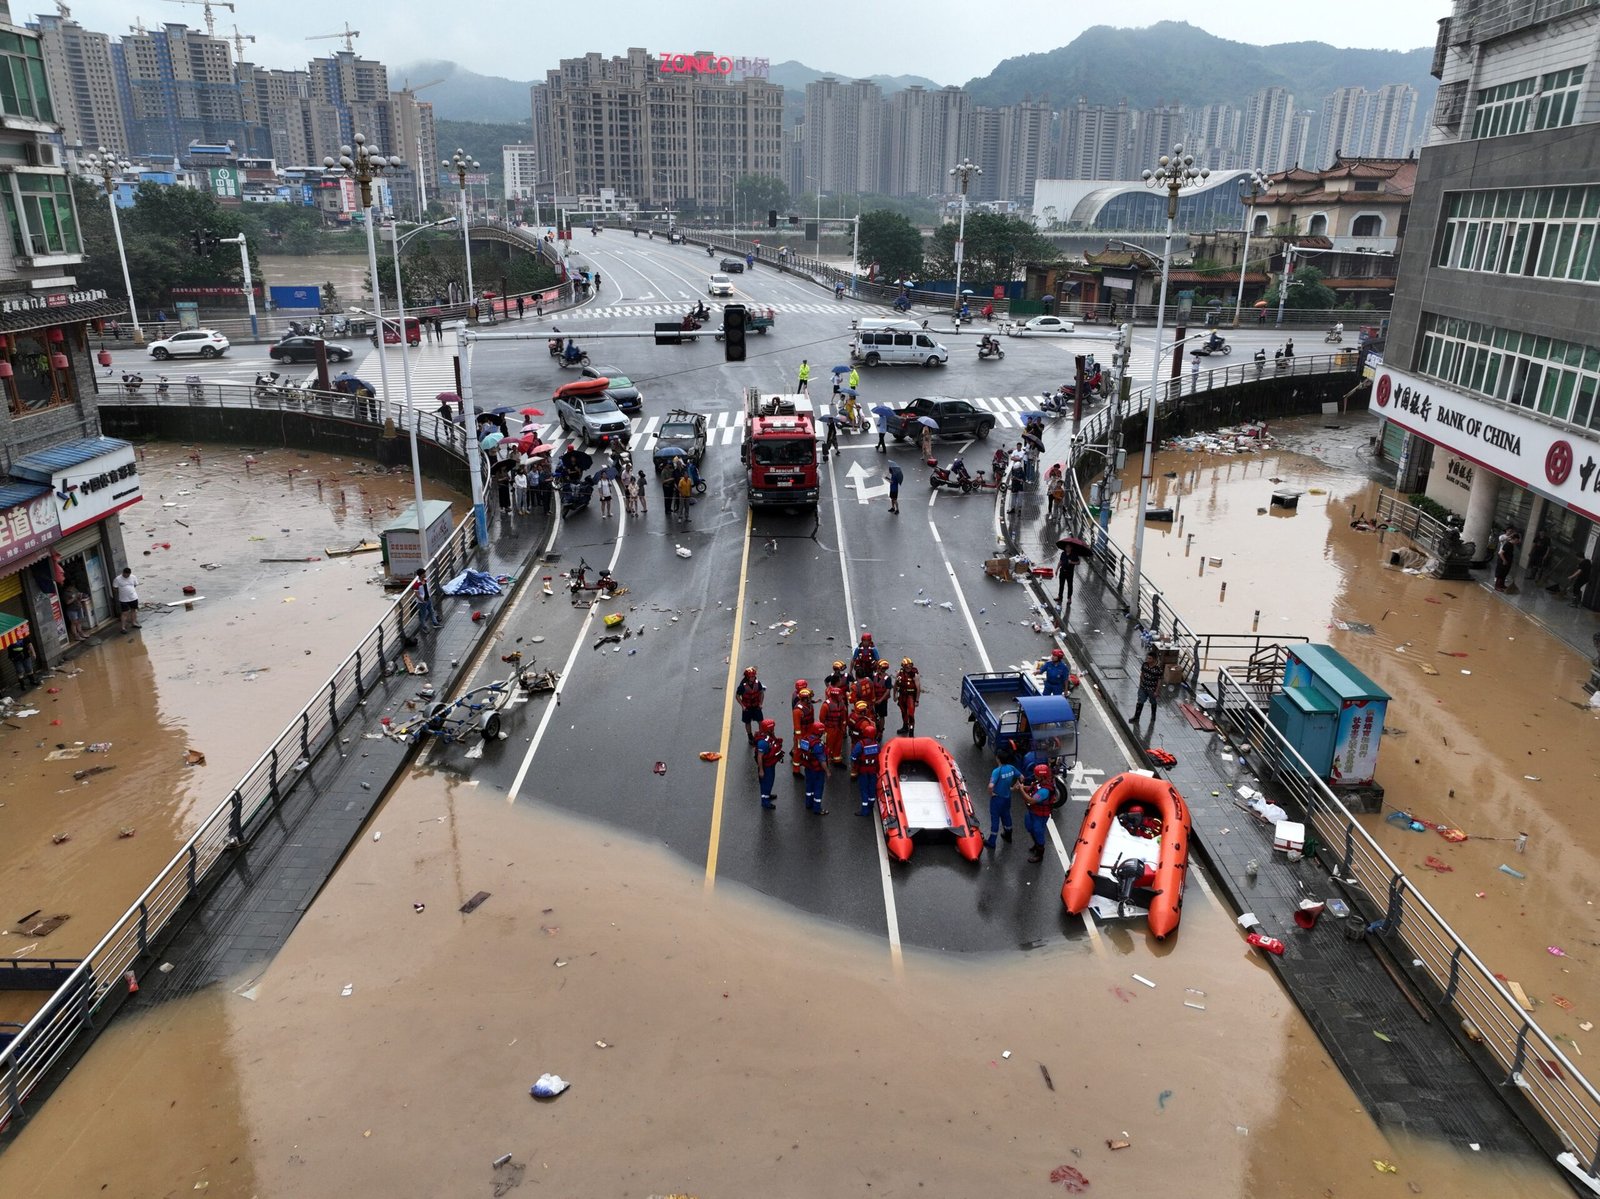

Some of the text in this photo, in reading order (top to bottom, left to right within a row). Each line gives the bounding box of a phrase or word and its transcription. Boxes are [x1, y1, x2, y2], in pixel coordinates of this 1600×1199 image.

[659, 53, 734, 75] ZONCO
[1394, 383, 1432, 422] 中国银行
[1437, 405, 1521, 456] BANK OF CHINA
[80, 462, 137, 495] 中国体育彩票
[1448, 459, 1473, 484] 中国银行
